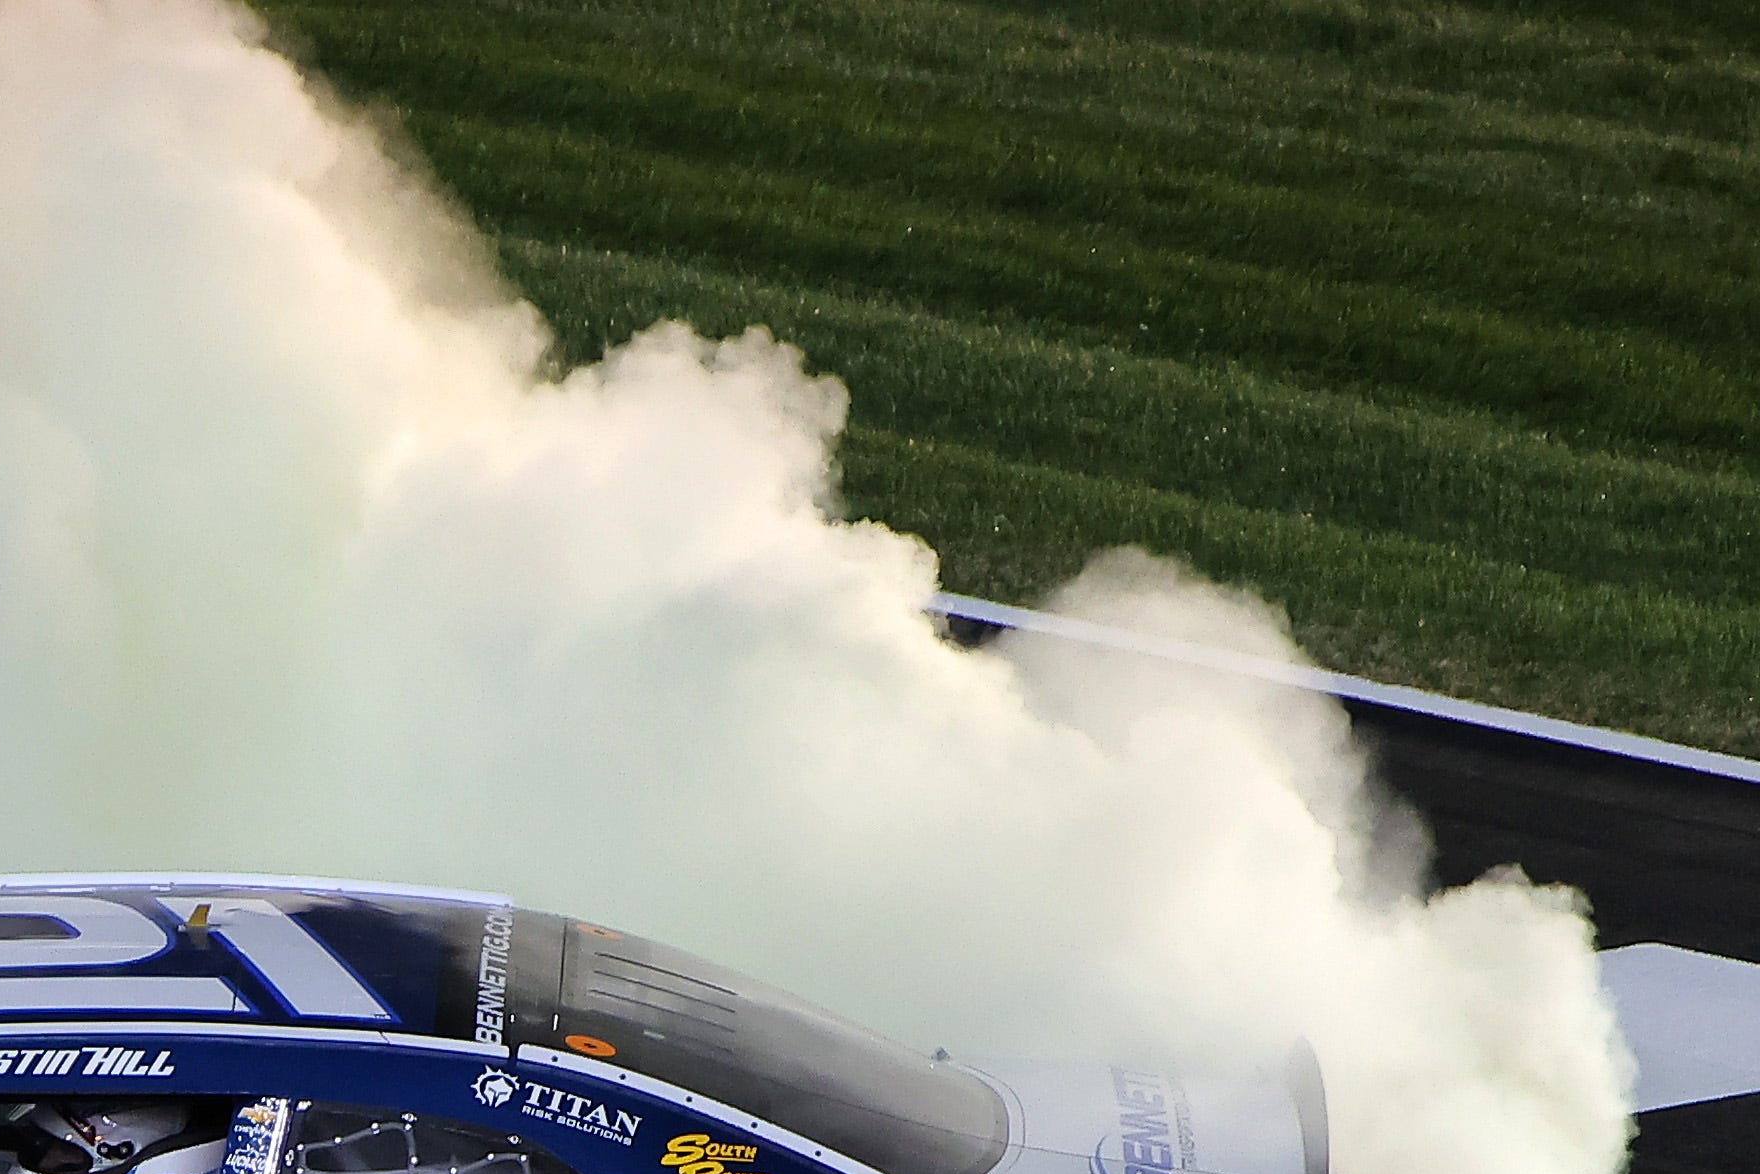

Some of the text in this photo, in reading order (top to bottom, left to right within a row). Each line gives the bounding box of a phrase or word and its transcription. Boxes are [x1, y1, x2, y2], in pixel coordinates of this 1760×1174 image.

[81, 1047, 175, 1077] HILL
[521, 1105, 633, 1147] RISK SOLUTIONS
[524, 1081, 643, 1137] TITAN
